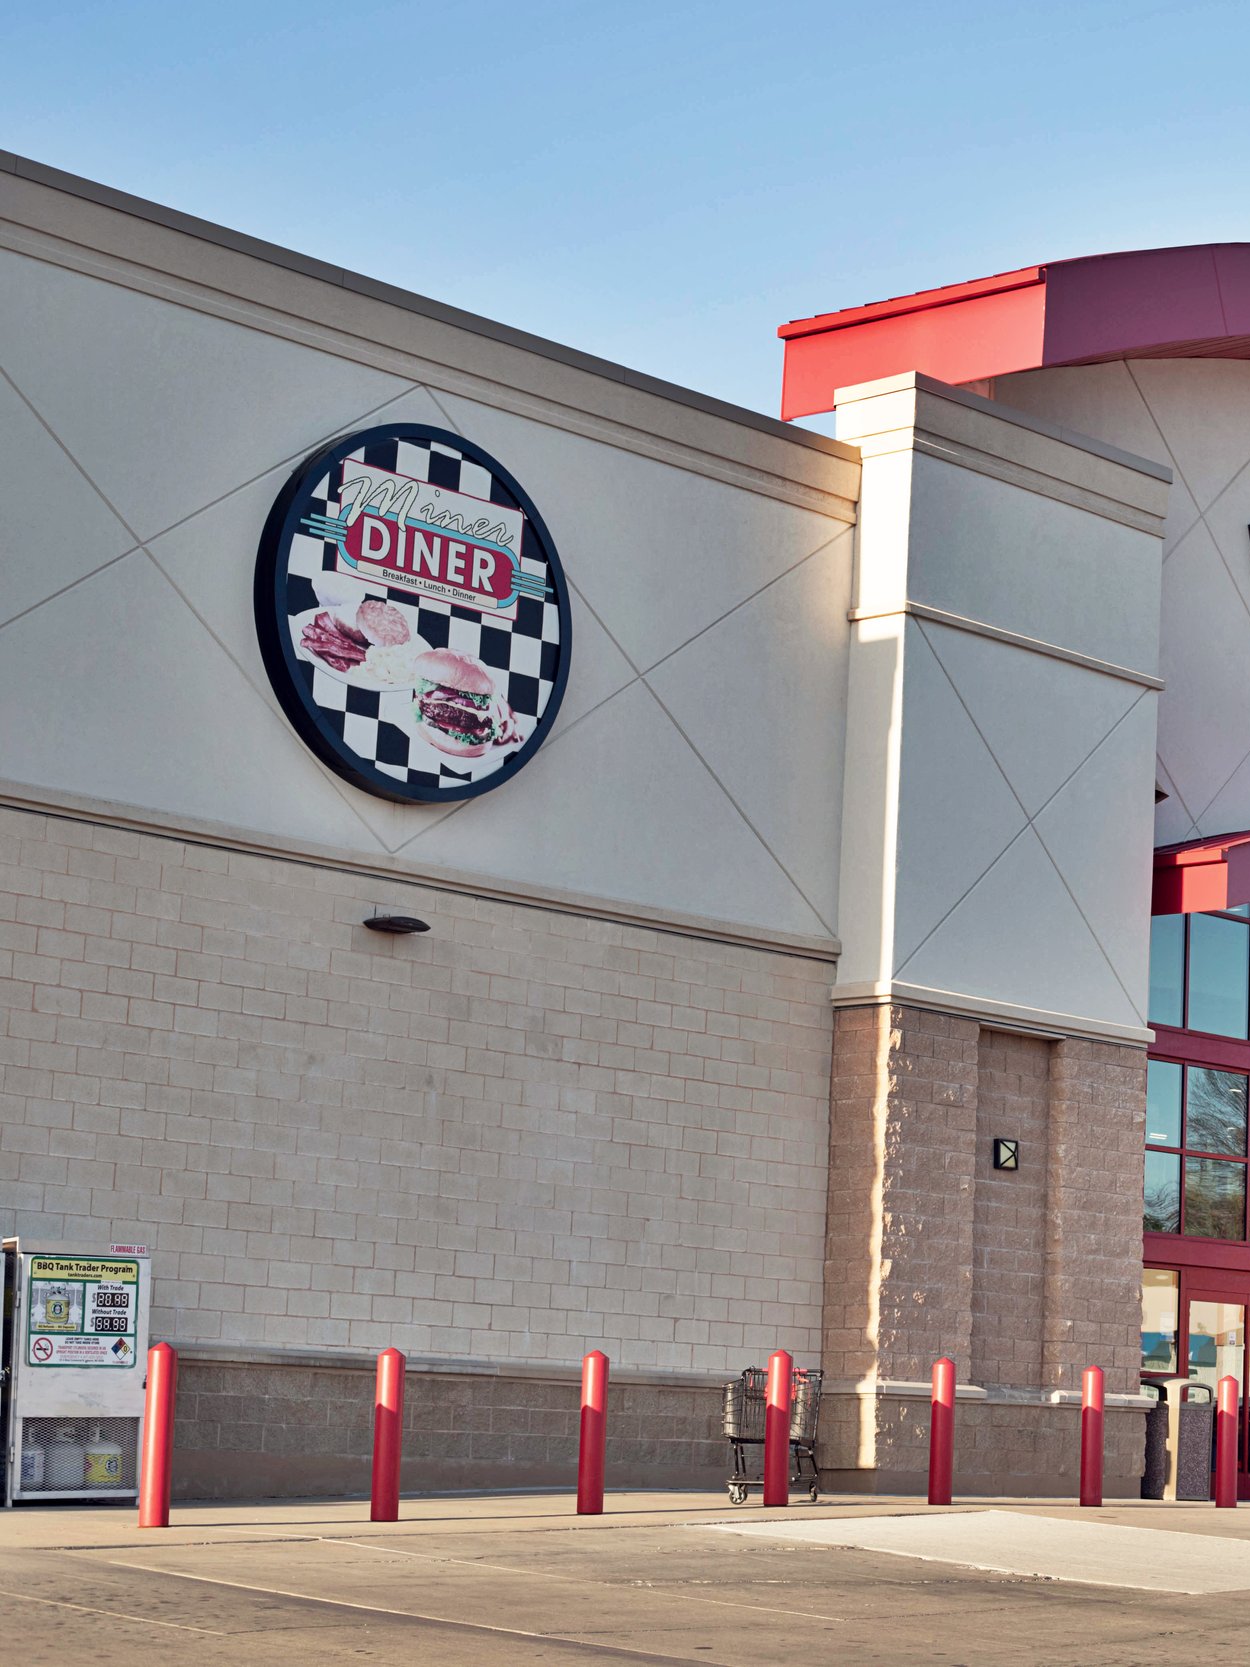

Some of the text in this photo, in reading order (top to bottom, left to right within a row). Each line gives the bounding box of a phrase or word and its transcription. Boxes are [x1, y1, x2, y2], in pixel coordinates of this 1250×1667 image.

[337, 476, 514, 547] Miner
[361, 515, 496, 593] DINER
[382, 570, 476, 602] Breakfast Lunch Dinner
[136, 1246, 146, 1254] GAS
[37, 1262, 133, 1275] BBQ Tank Trader Program
